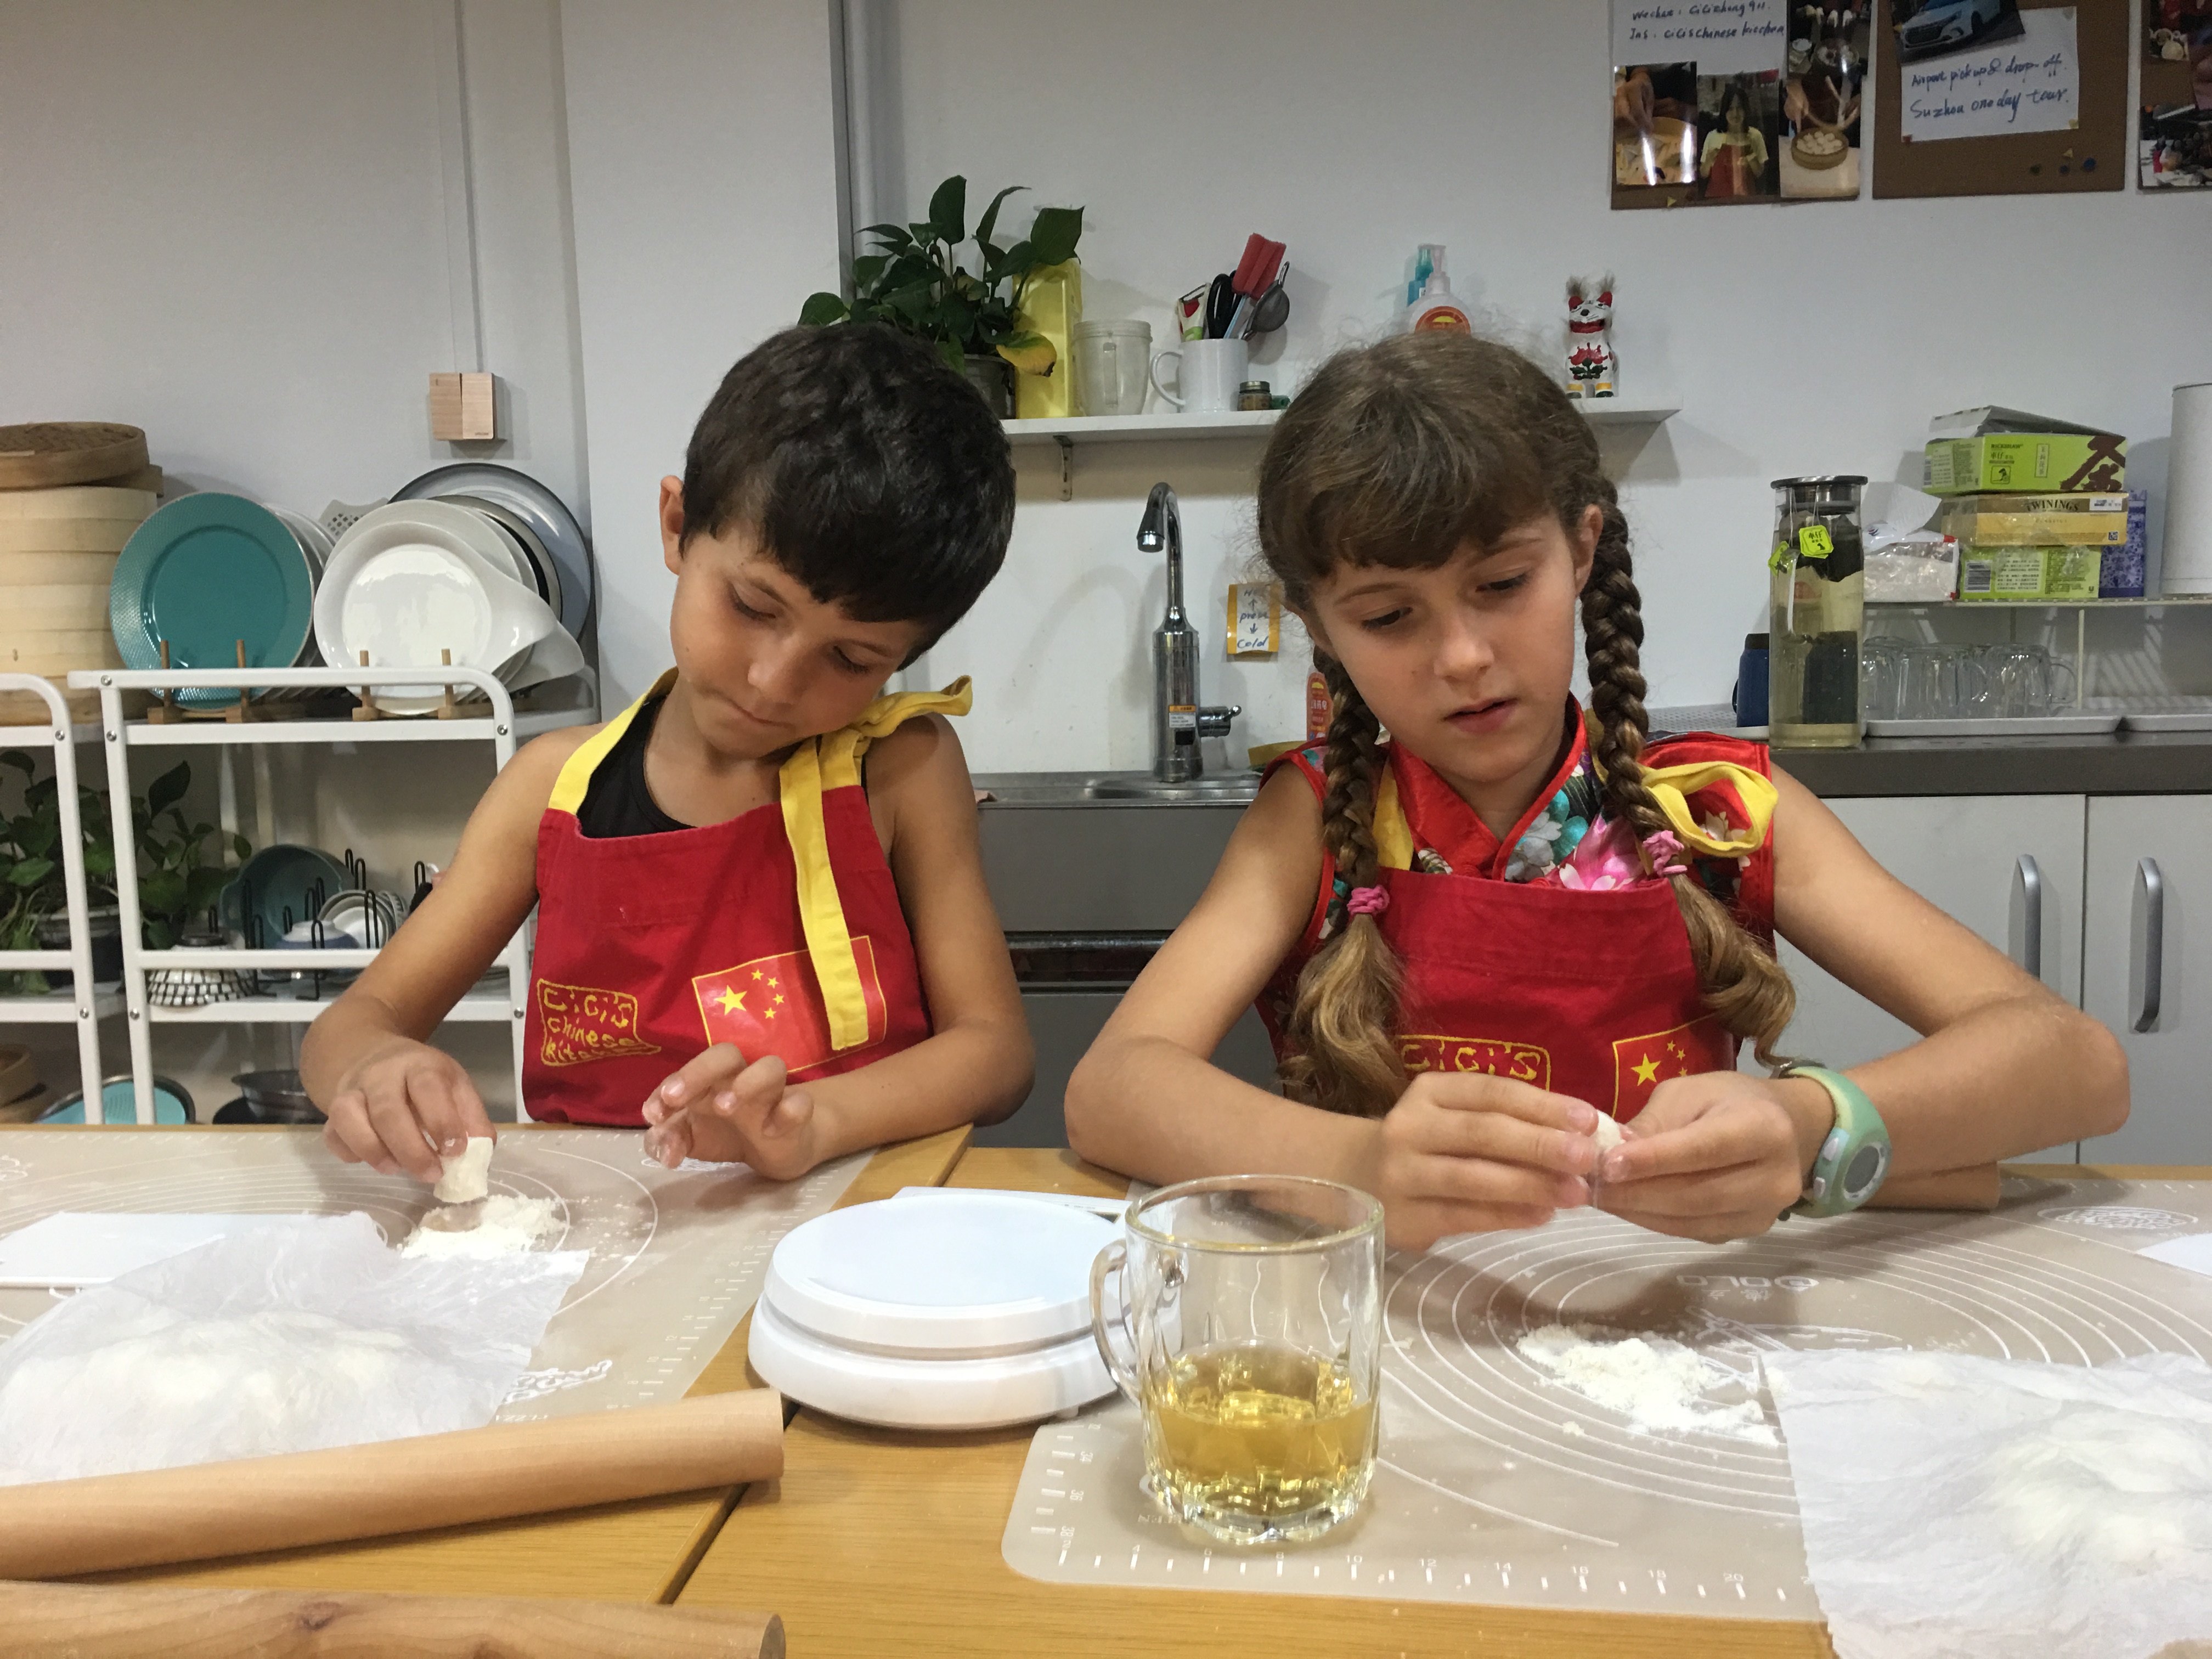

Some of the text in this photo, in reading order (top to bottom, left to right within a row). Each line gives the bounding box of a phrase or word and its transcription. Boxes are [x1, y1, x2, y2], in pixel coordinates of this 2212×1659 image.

[1910, 99, 1965, 119] Suzhou
[1971, 99, 1994, 111] one
[1997, 88, 2021, 123] day
[2025, 498, 2080, 512] TWININGS
[1080, 1451, 1093, 1463] 34
[1070, 1489, 1084, 1501] 36
[1060, 1526, 1074, 1537] 38
[1132, 1544, 1141, 1553] 4
[1276, 1551, 1285, 1560] 8
[1346, 1555, 1362, 1563] 10
[1419, 1558, 1437, 1567] 12
[1496, 1562, 1511, 1571] 14
[1723, 1572, 1743, 1582] 20
